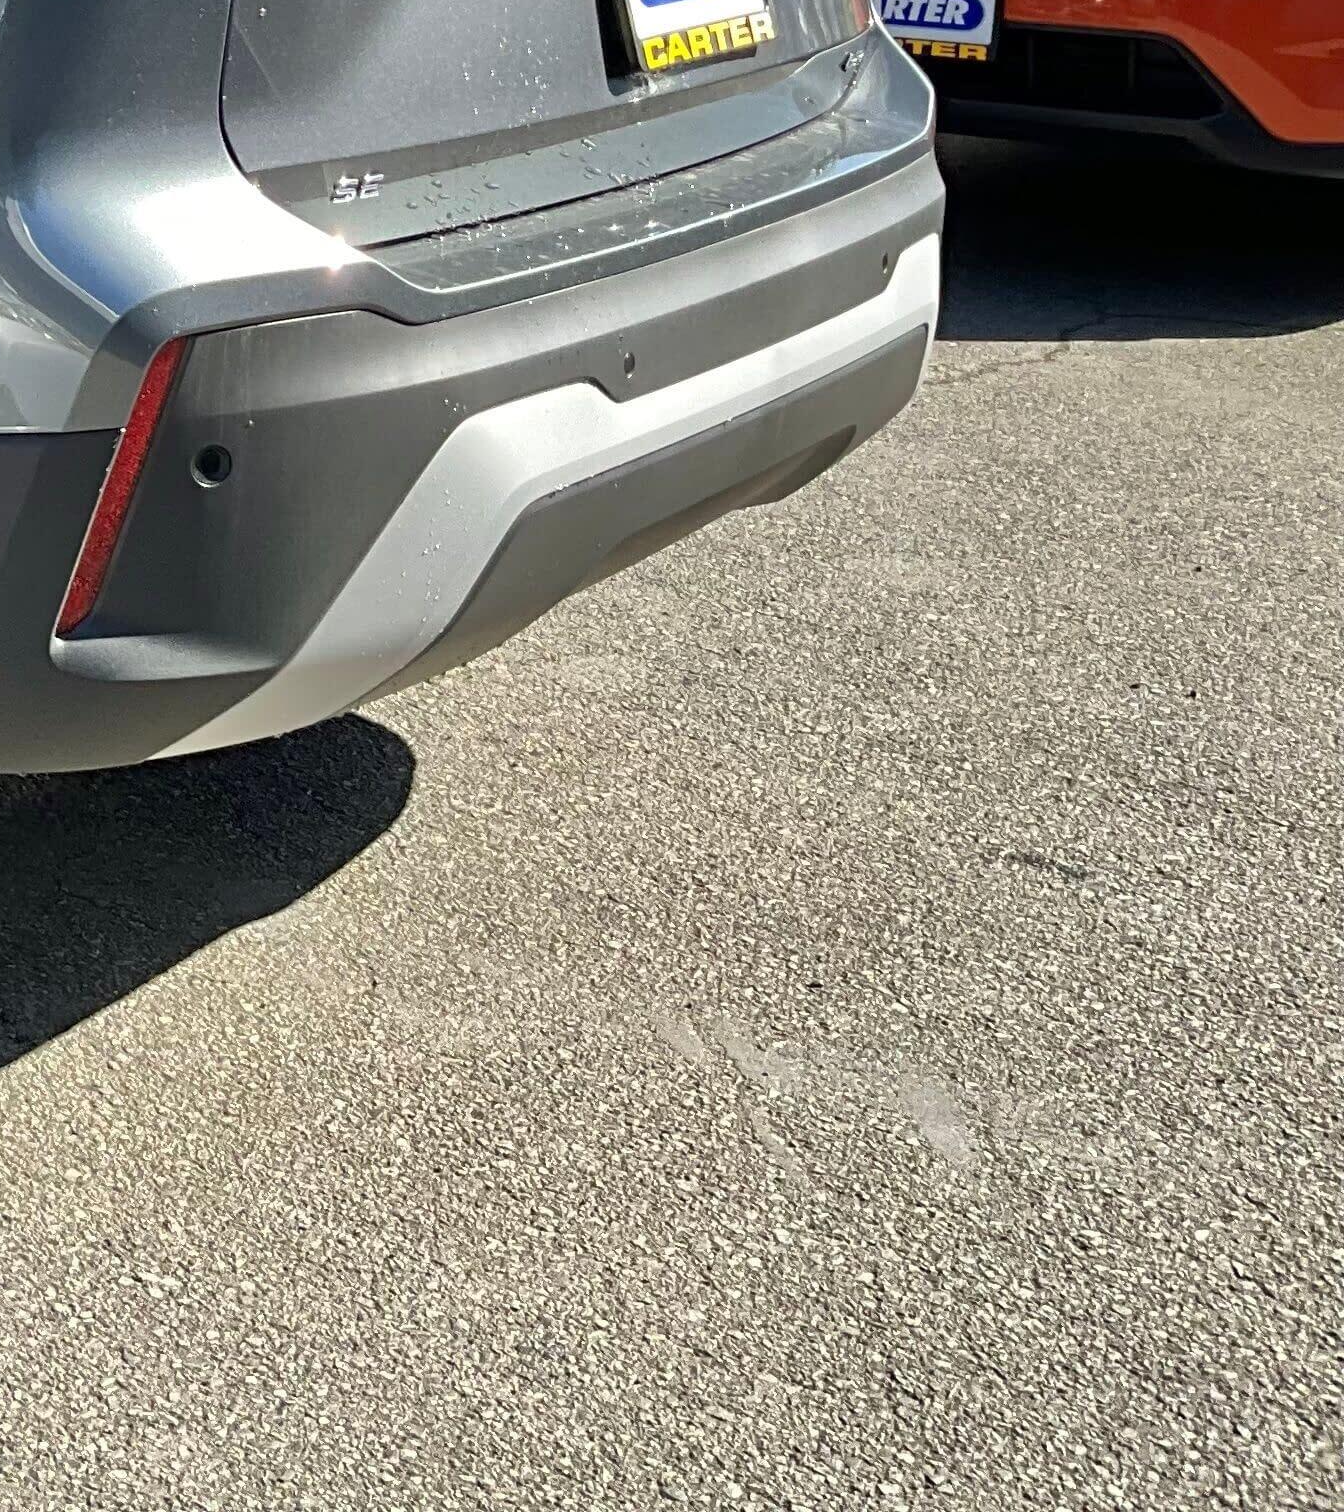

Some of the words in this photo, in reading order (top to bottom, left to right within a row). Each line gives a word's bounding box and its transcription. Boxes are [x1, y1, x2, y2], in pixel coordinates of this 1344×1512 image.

[643, 11, 775, 70] CARTER
[896, 39, 988, 61] TER
[332, 174, 384, 204] SE
